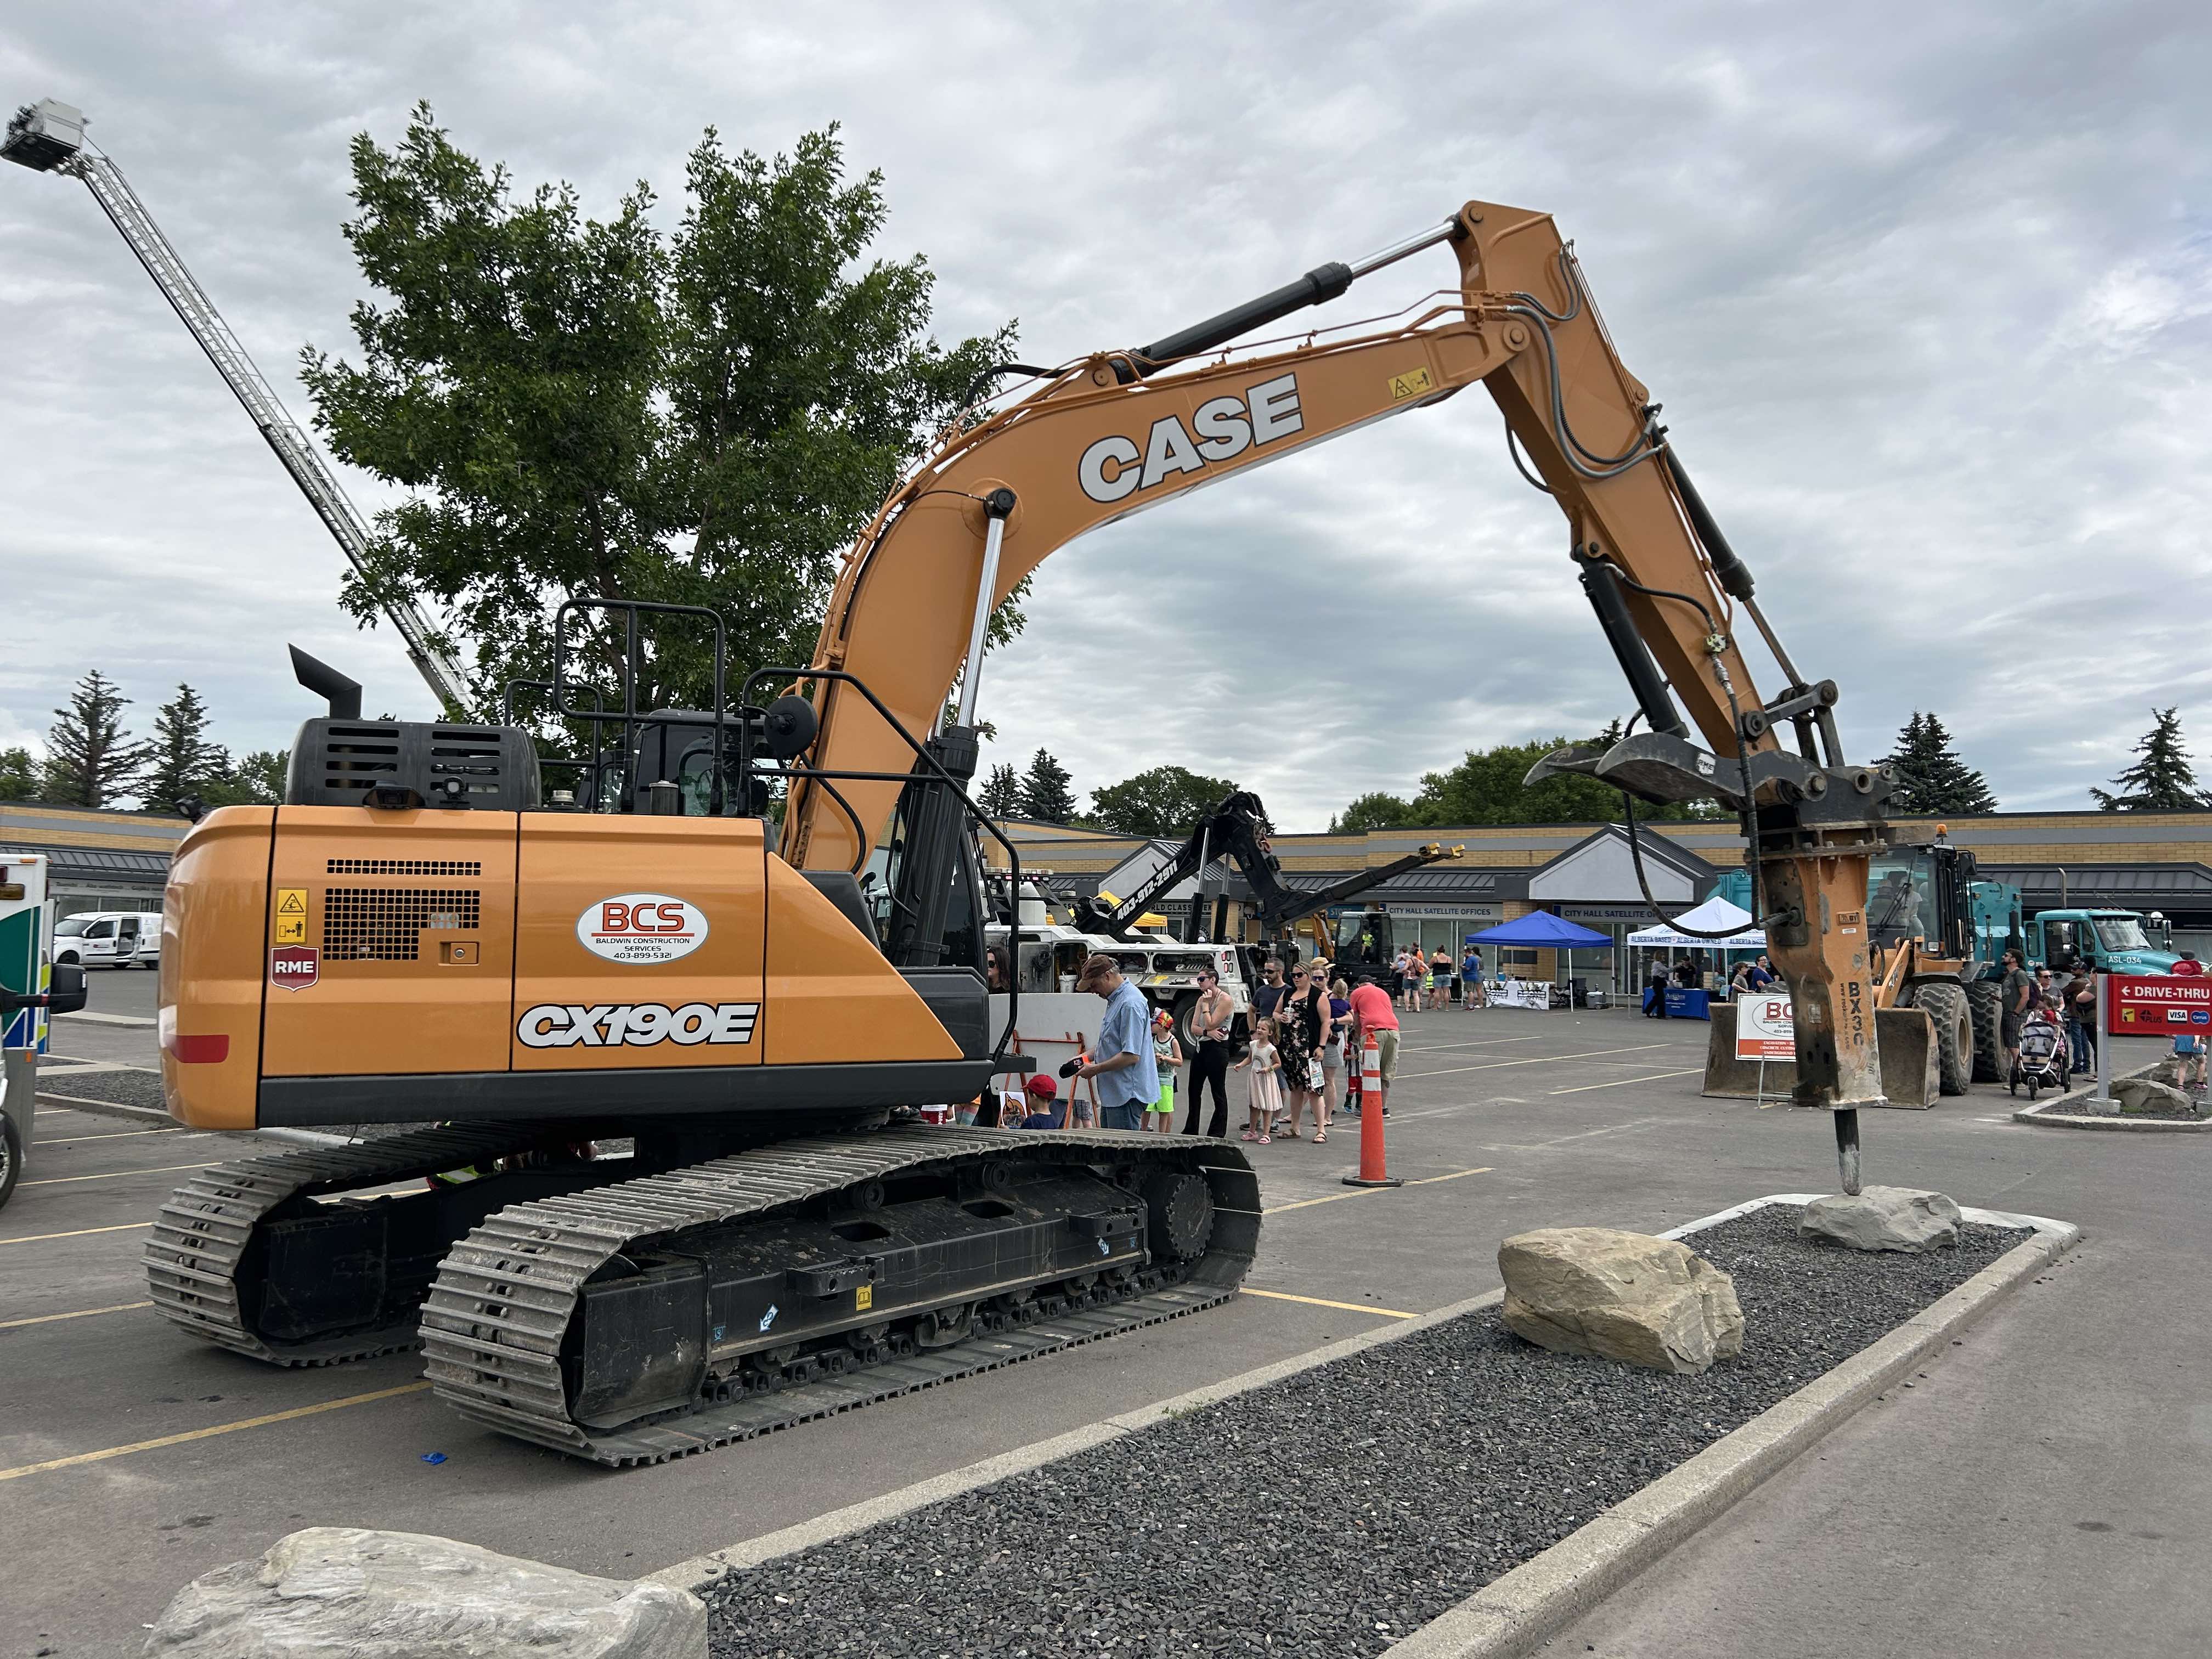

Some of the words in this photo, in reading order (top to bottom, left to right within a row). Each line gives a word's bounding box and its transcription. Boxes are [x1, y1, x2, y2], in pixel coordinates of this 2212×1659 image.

[1078, 371, 1305, 503] CASE
[1117, 859, 1178, 921] 403-912-2911
[602, 902, 685, 932] BCS
[275, 961, 314, 973] RME
[2108, 956, 2142, 964] ASL-034
[2135, 986, 2210, 1000] DRIVE-THRU
[1766, 1002, 1792, 1018] BC
[516, 1002, 761, 1049] CX190E
